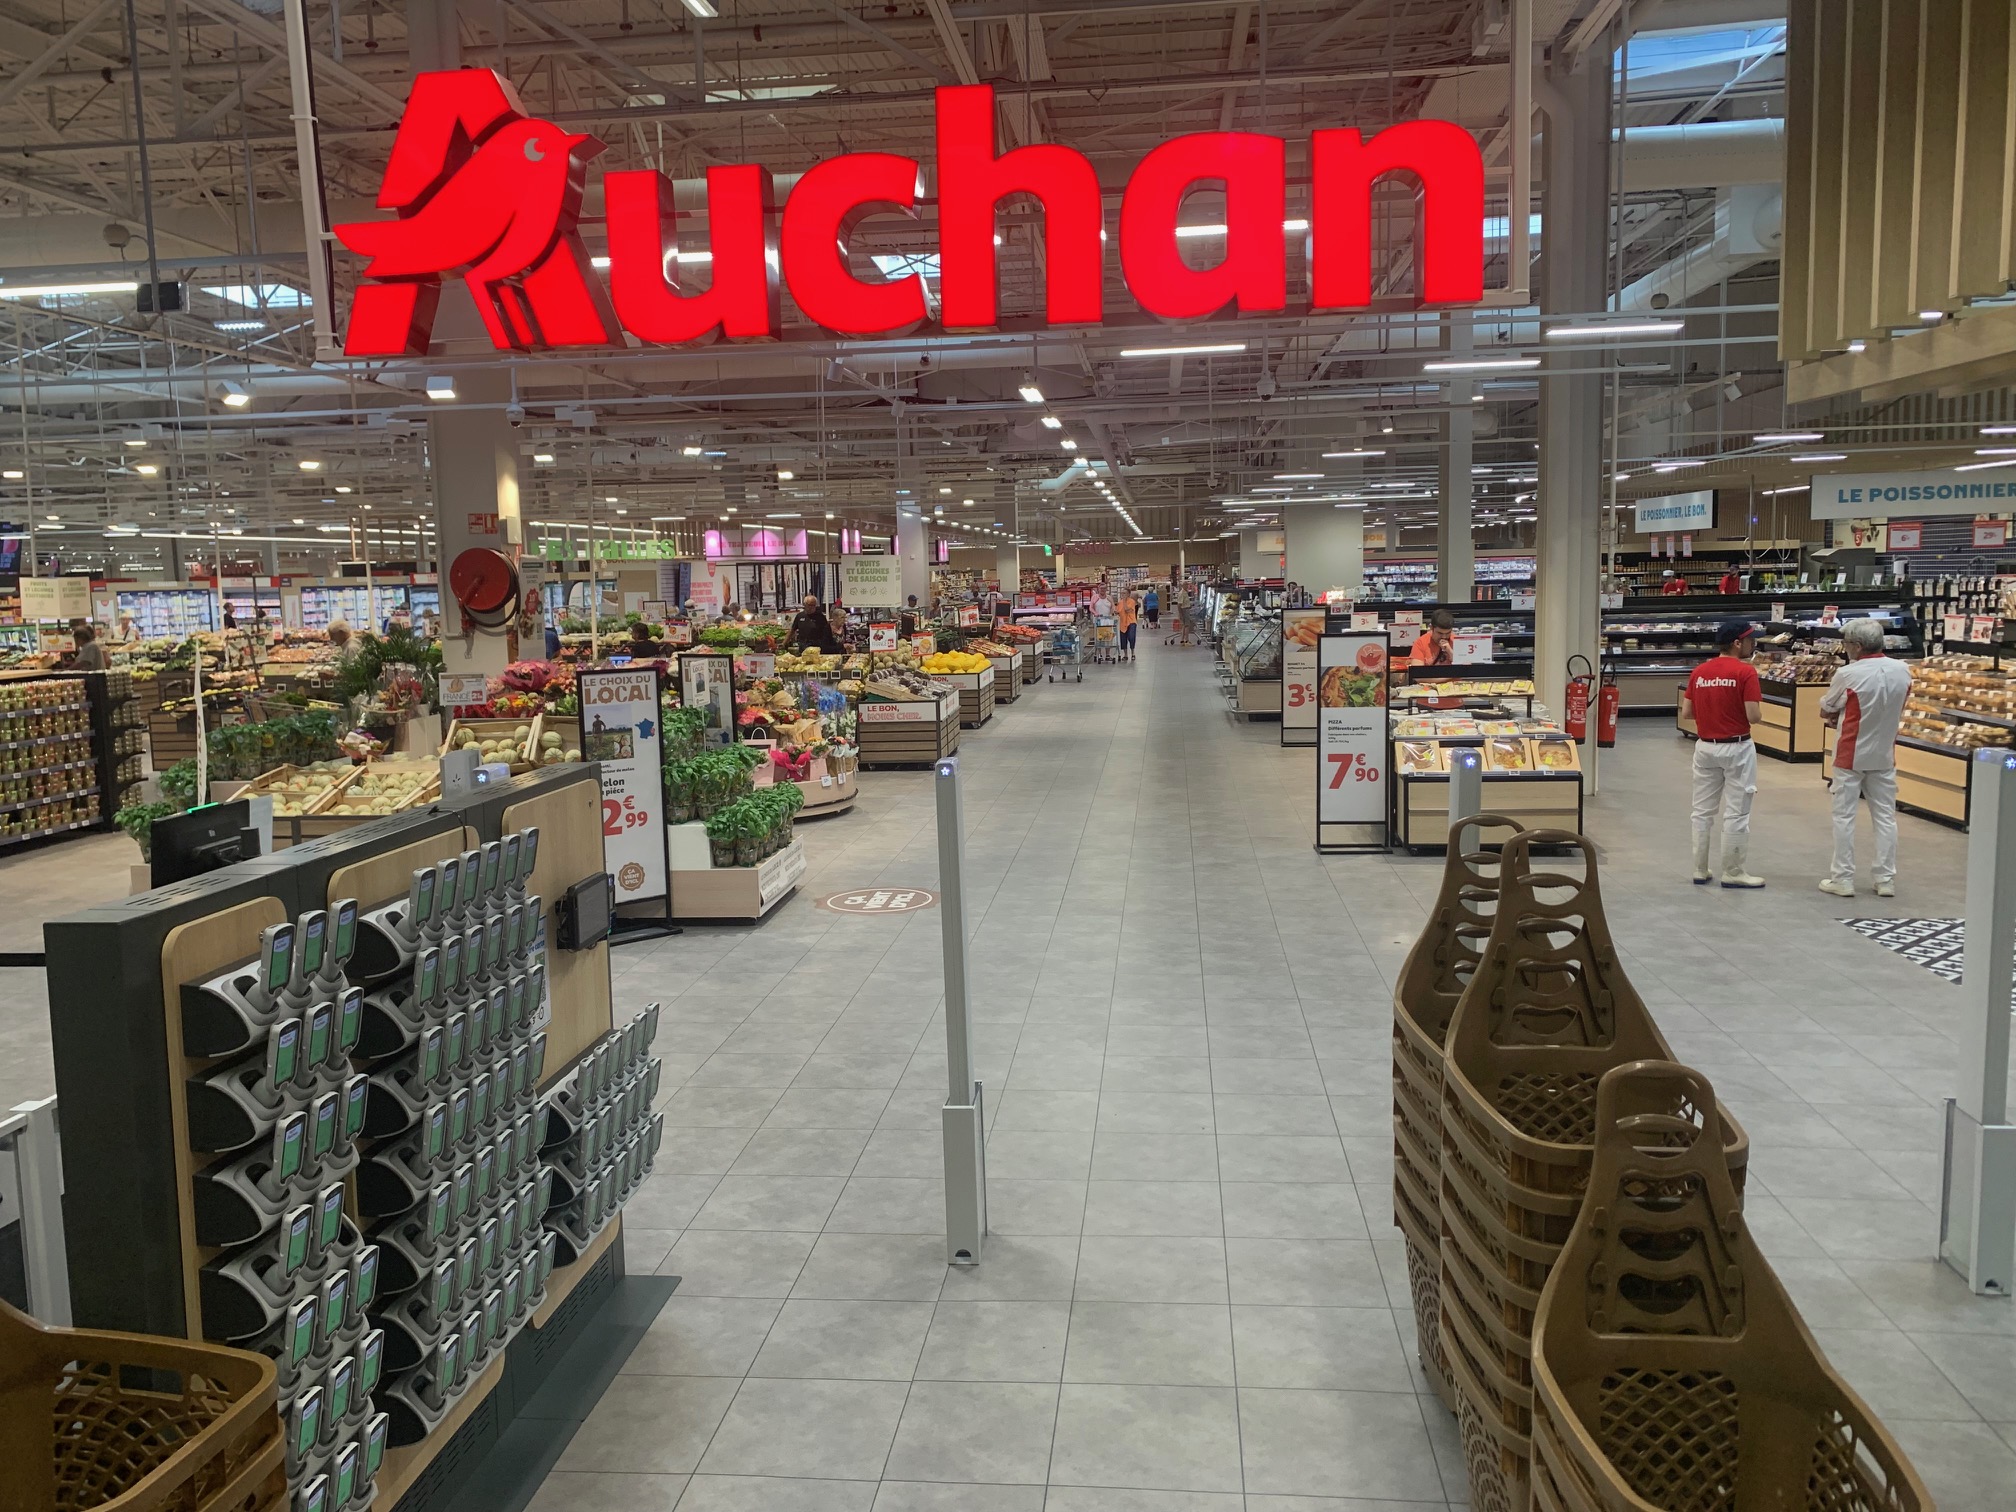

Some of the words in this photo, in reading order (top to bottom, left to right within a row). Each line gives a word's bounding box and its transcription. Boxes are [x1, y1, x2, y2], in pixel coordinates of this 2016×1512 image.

[334, 68, 1485, 356] Auchan
[1838, 488, 1863, 503] LE
[1869, 482, 2016, 503] POISSONNIER
[1640, 510, 1647, 521] LE
[1647, 506, 1684, 520] POISSONNIER,
[1685, 505, 1691, 516] LE
[1692, 503, 1707, 516] BON.
[856, 566, 890, 575] LÉGUMES
[584, 678, 597, 687] LE
[599, 676, 633, 686] CHOIX
[636, 675, 651, 684] DU
[684, 668, 729, 684] LAL
[1696, 676, 1737, 688] Auchan
[584, 684, 652, 704] LOCAL
[867, 712, 895, 720] MOINS
[879, 705, 900, 713] BON,
[1328, 754, 1354, 790] 7
[601, 778, 625, 788] elon
[603, 799, 622, 836] 2
